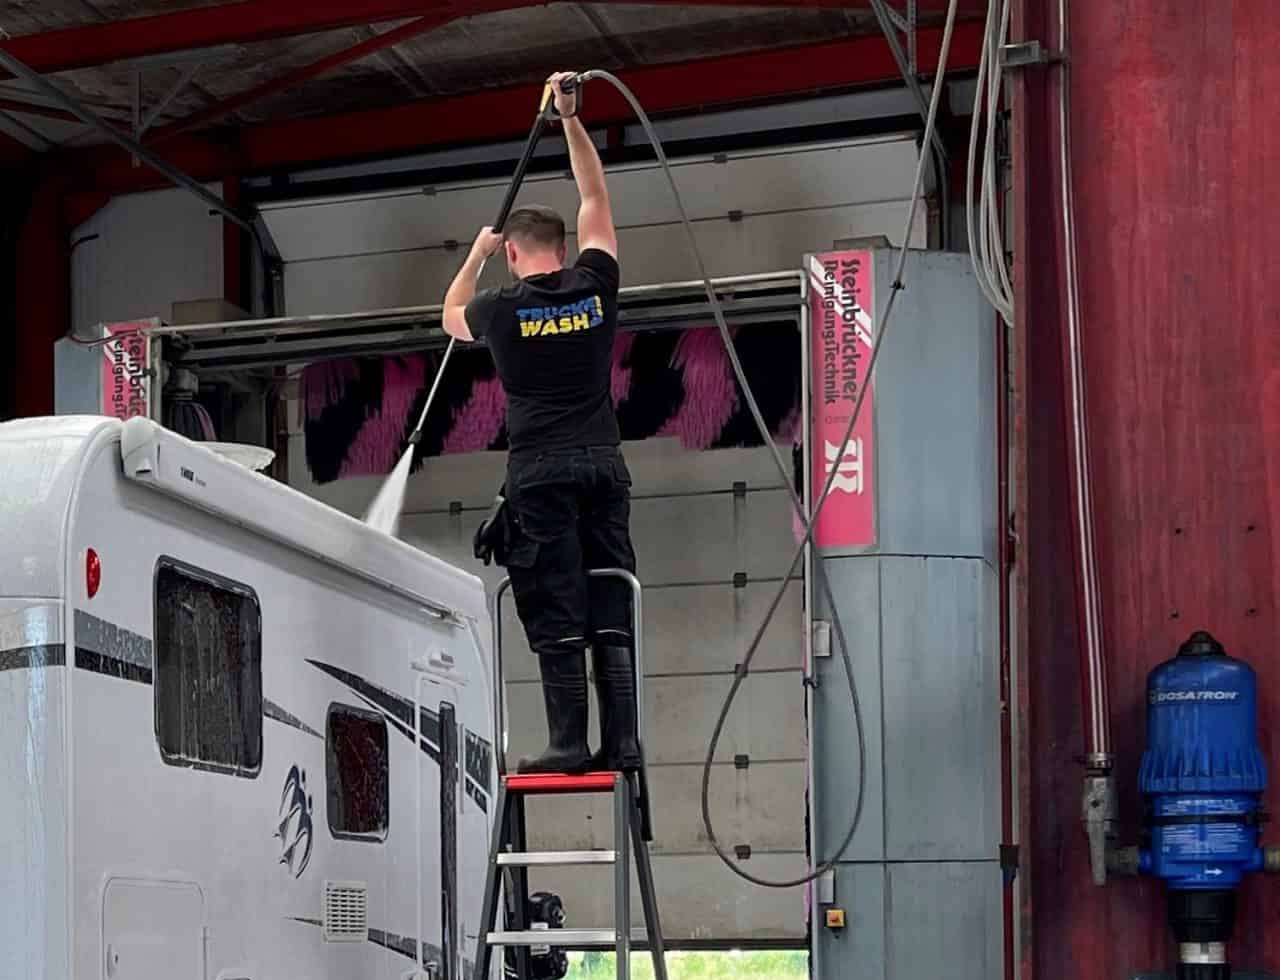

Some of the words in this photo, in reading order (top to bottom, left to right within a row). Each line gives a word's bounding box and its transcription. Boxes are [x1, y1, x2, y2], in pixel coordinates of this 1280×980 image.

[520, 312, 590, 337] WASH
[841, 258, 861, 403] Steinbrückner
[1158, 690, 1240, 702] DOSATRON
